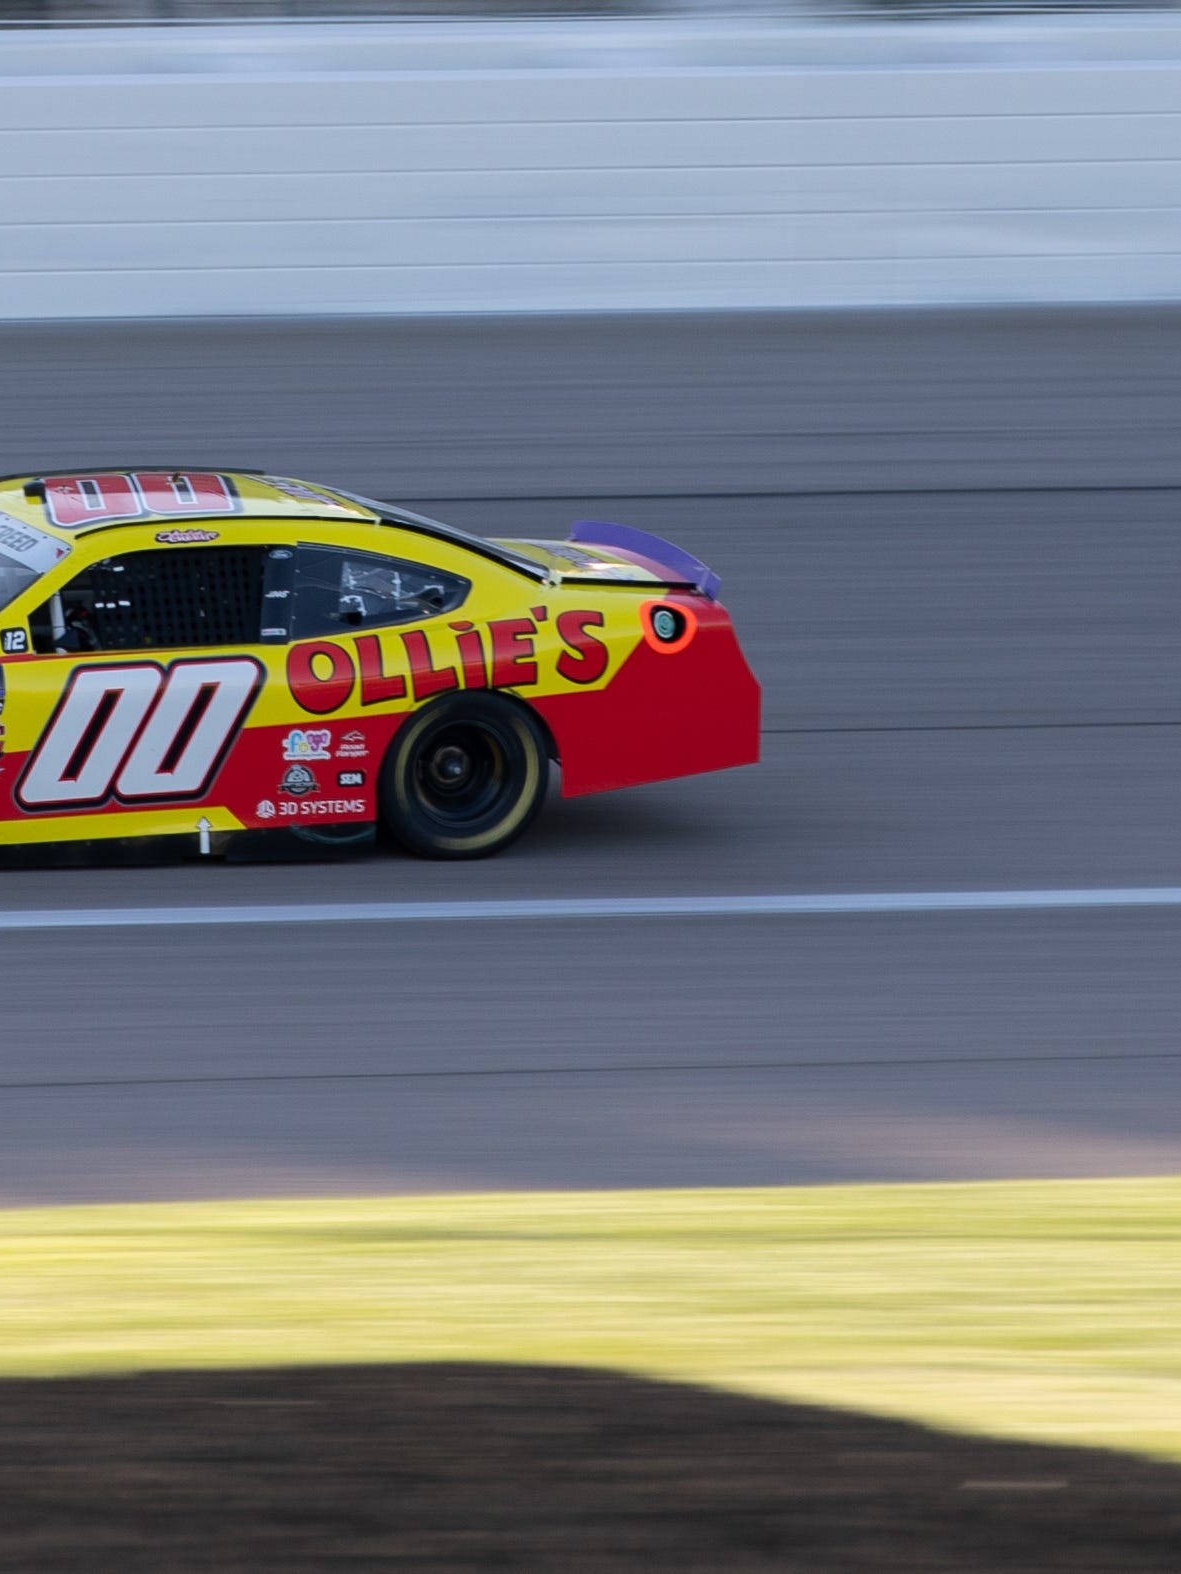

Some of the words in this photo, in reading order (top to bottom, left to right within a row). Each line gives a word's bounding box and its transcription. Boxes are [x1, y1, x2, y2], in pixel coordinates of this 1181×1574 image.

[43, 471, 238, 528] 00
[4, 630, 26, 650] 12
[14, 655, 267, 813] 00
[339, 772, 363, 785] SEM
[278, 801, 298, 816] 3D
[300, 799, 367, 815] SYSTEMS
